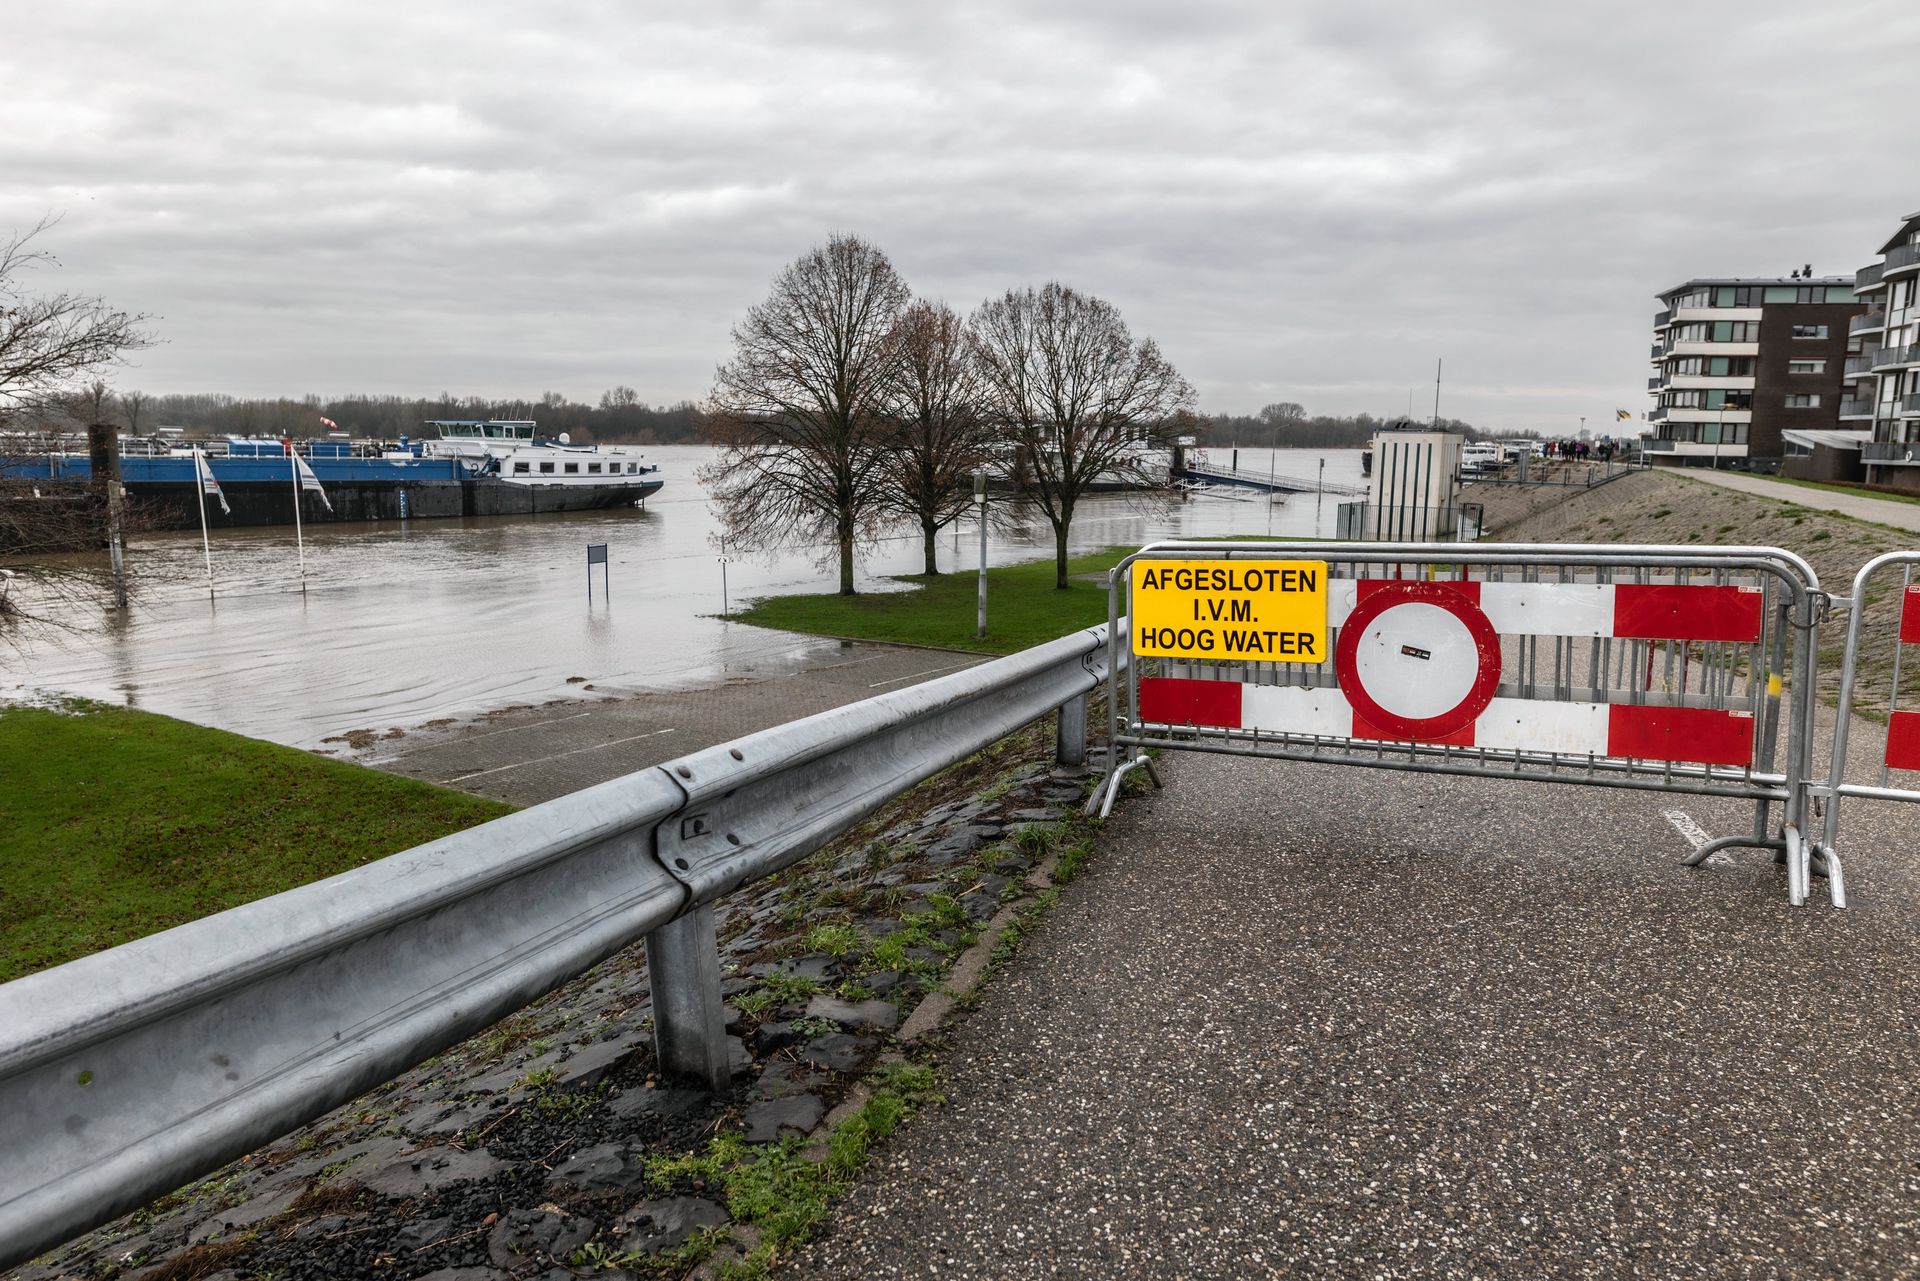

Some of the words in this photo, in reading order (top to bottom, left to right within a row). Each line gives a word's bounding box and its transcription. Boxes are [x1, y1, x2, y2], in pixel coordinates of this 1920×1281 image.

[1141, 568, 1316, 593] AFGESLOTEN
[1193, 598, 1259, 623] I.V.M.
[1141, 627, 1215, 651] HOOG
[1222, 630, 1316, 655] WATER
